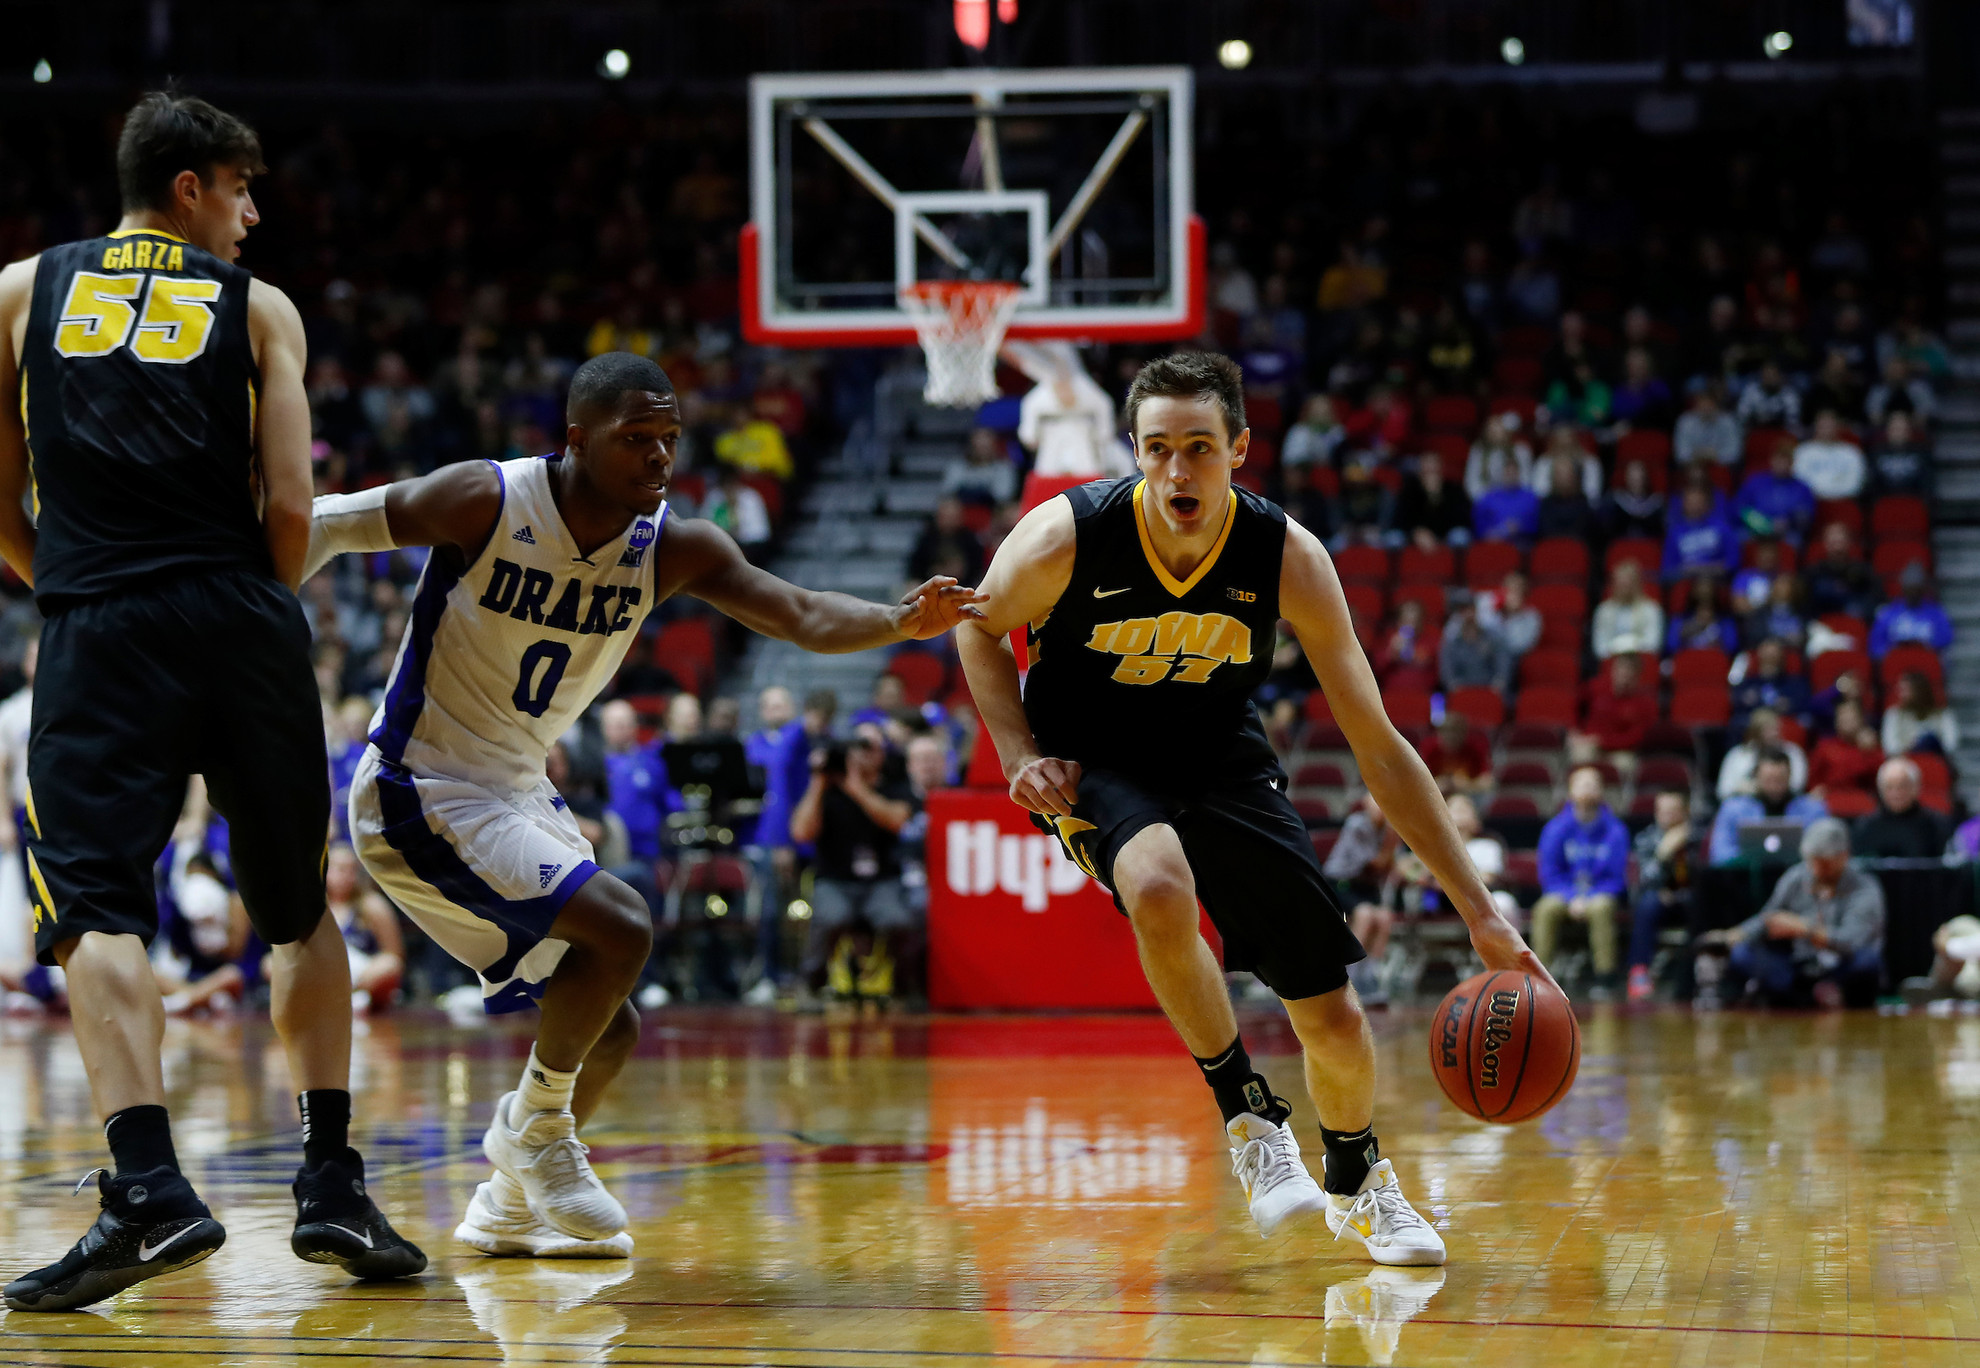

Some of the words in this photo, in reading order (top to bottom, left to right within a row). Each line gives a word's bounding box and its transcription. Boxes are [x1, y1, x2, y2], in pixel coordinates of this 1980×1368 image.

[102, 241, 184, 271] GARZA
[54, 271, 223, 364] 55
[478, 557, 642, 637] DRAKE
[1084, 611, 1254, 664] IOWA
[1111, 655, 1223, 685] 51
[511, 639, 572, 719] 0
[540, 863, 563, 889] adidas
[1441, 995, 1469, 1068] NCAA
[1481, 989, 1520, 1089] Wilson
